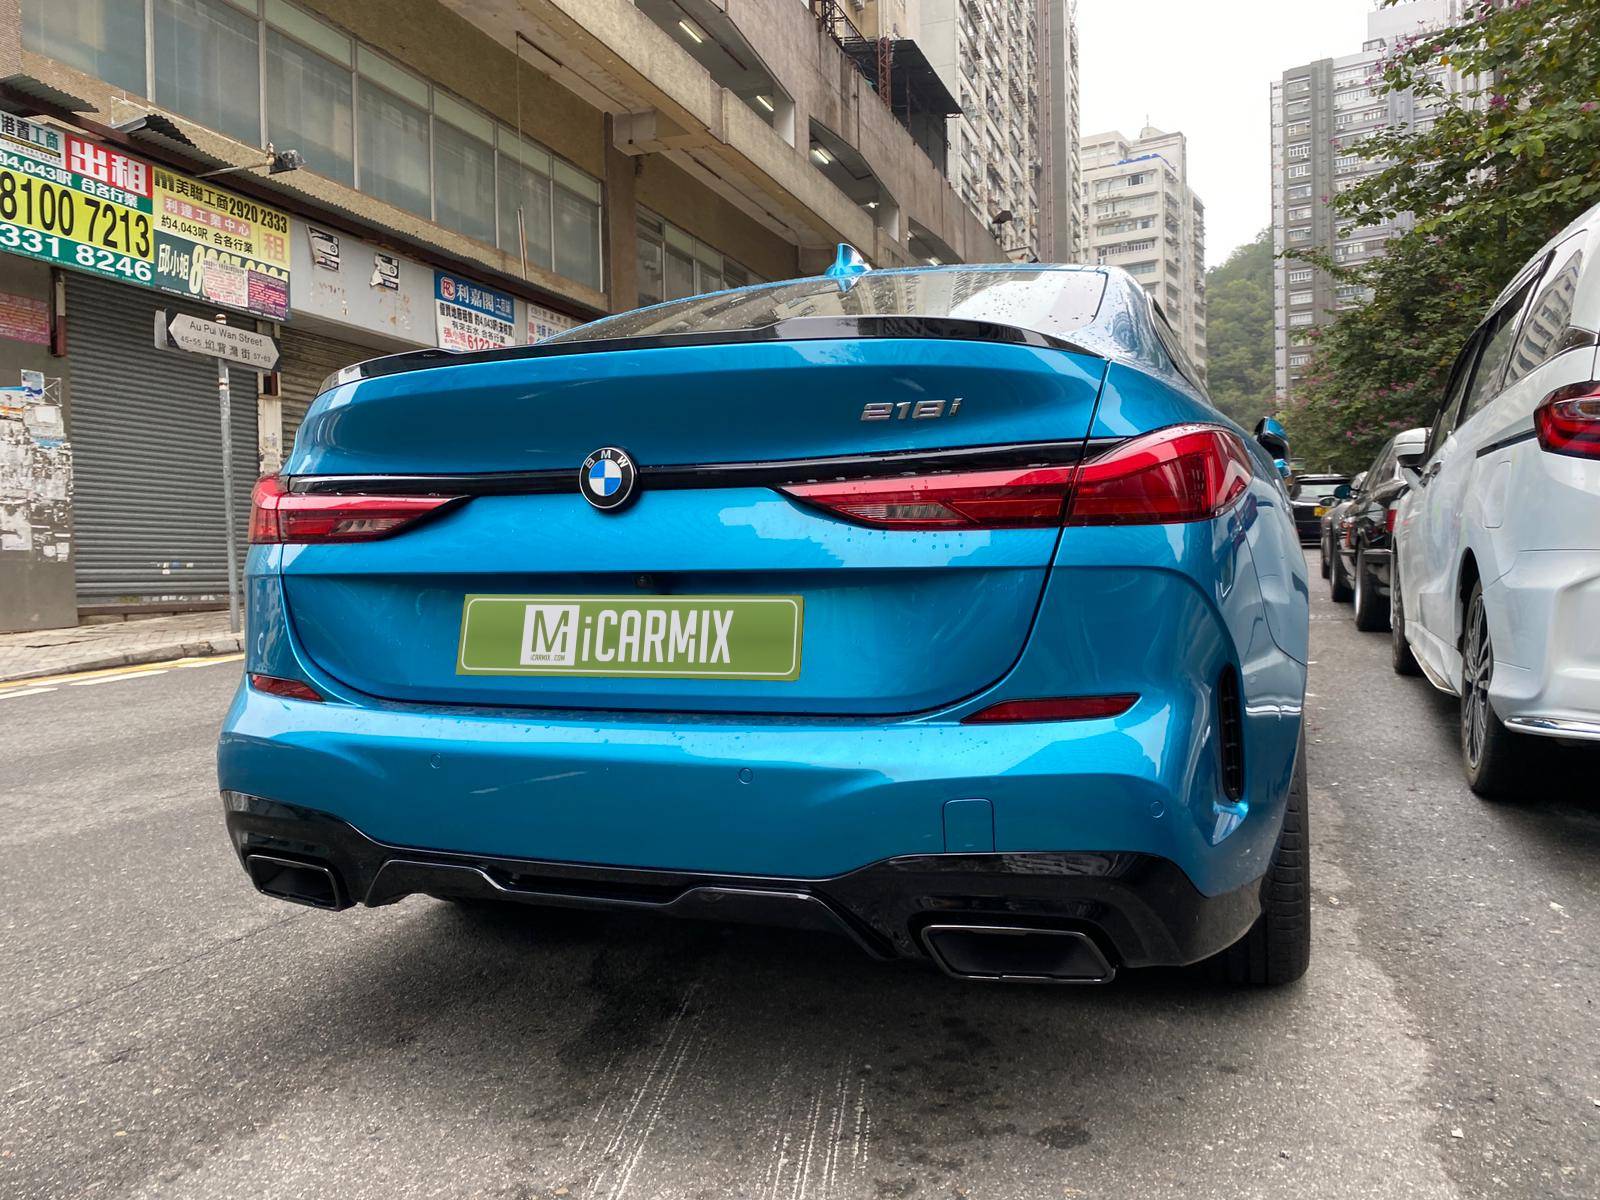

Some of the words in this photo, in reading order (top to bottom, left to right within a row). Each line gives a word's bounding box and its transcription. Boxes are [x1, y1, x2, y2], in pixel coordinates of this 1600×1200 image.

[1, 113, 59, 151] 港置工商
[70, 140, 148, 196] 出租
[0, 171, 75, 236] 8100
[84, 196, 150, 258] 7213
[176, 178, 228, 212] 美聯工商
[229, 197, 258, 223] 2920
[260, 209, 287, 234] 2333
[161, 214, 208, 240] 約4,043呎
[263, 233, 285, 261] 租
[75, 244, 152, 282] 8246
[456, 283, 495, 312] 利嘉閣
[190, 321, 202, 331] Au
[204, 324, 217, 335] Pui
[219, 328, 237, 341] Wan
[239, 333, 263, 347] Street
[861, 398, 964, 420] 218i
[585, 449, 629, 469] BMW
